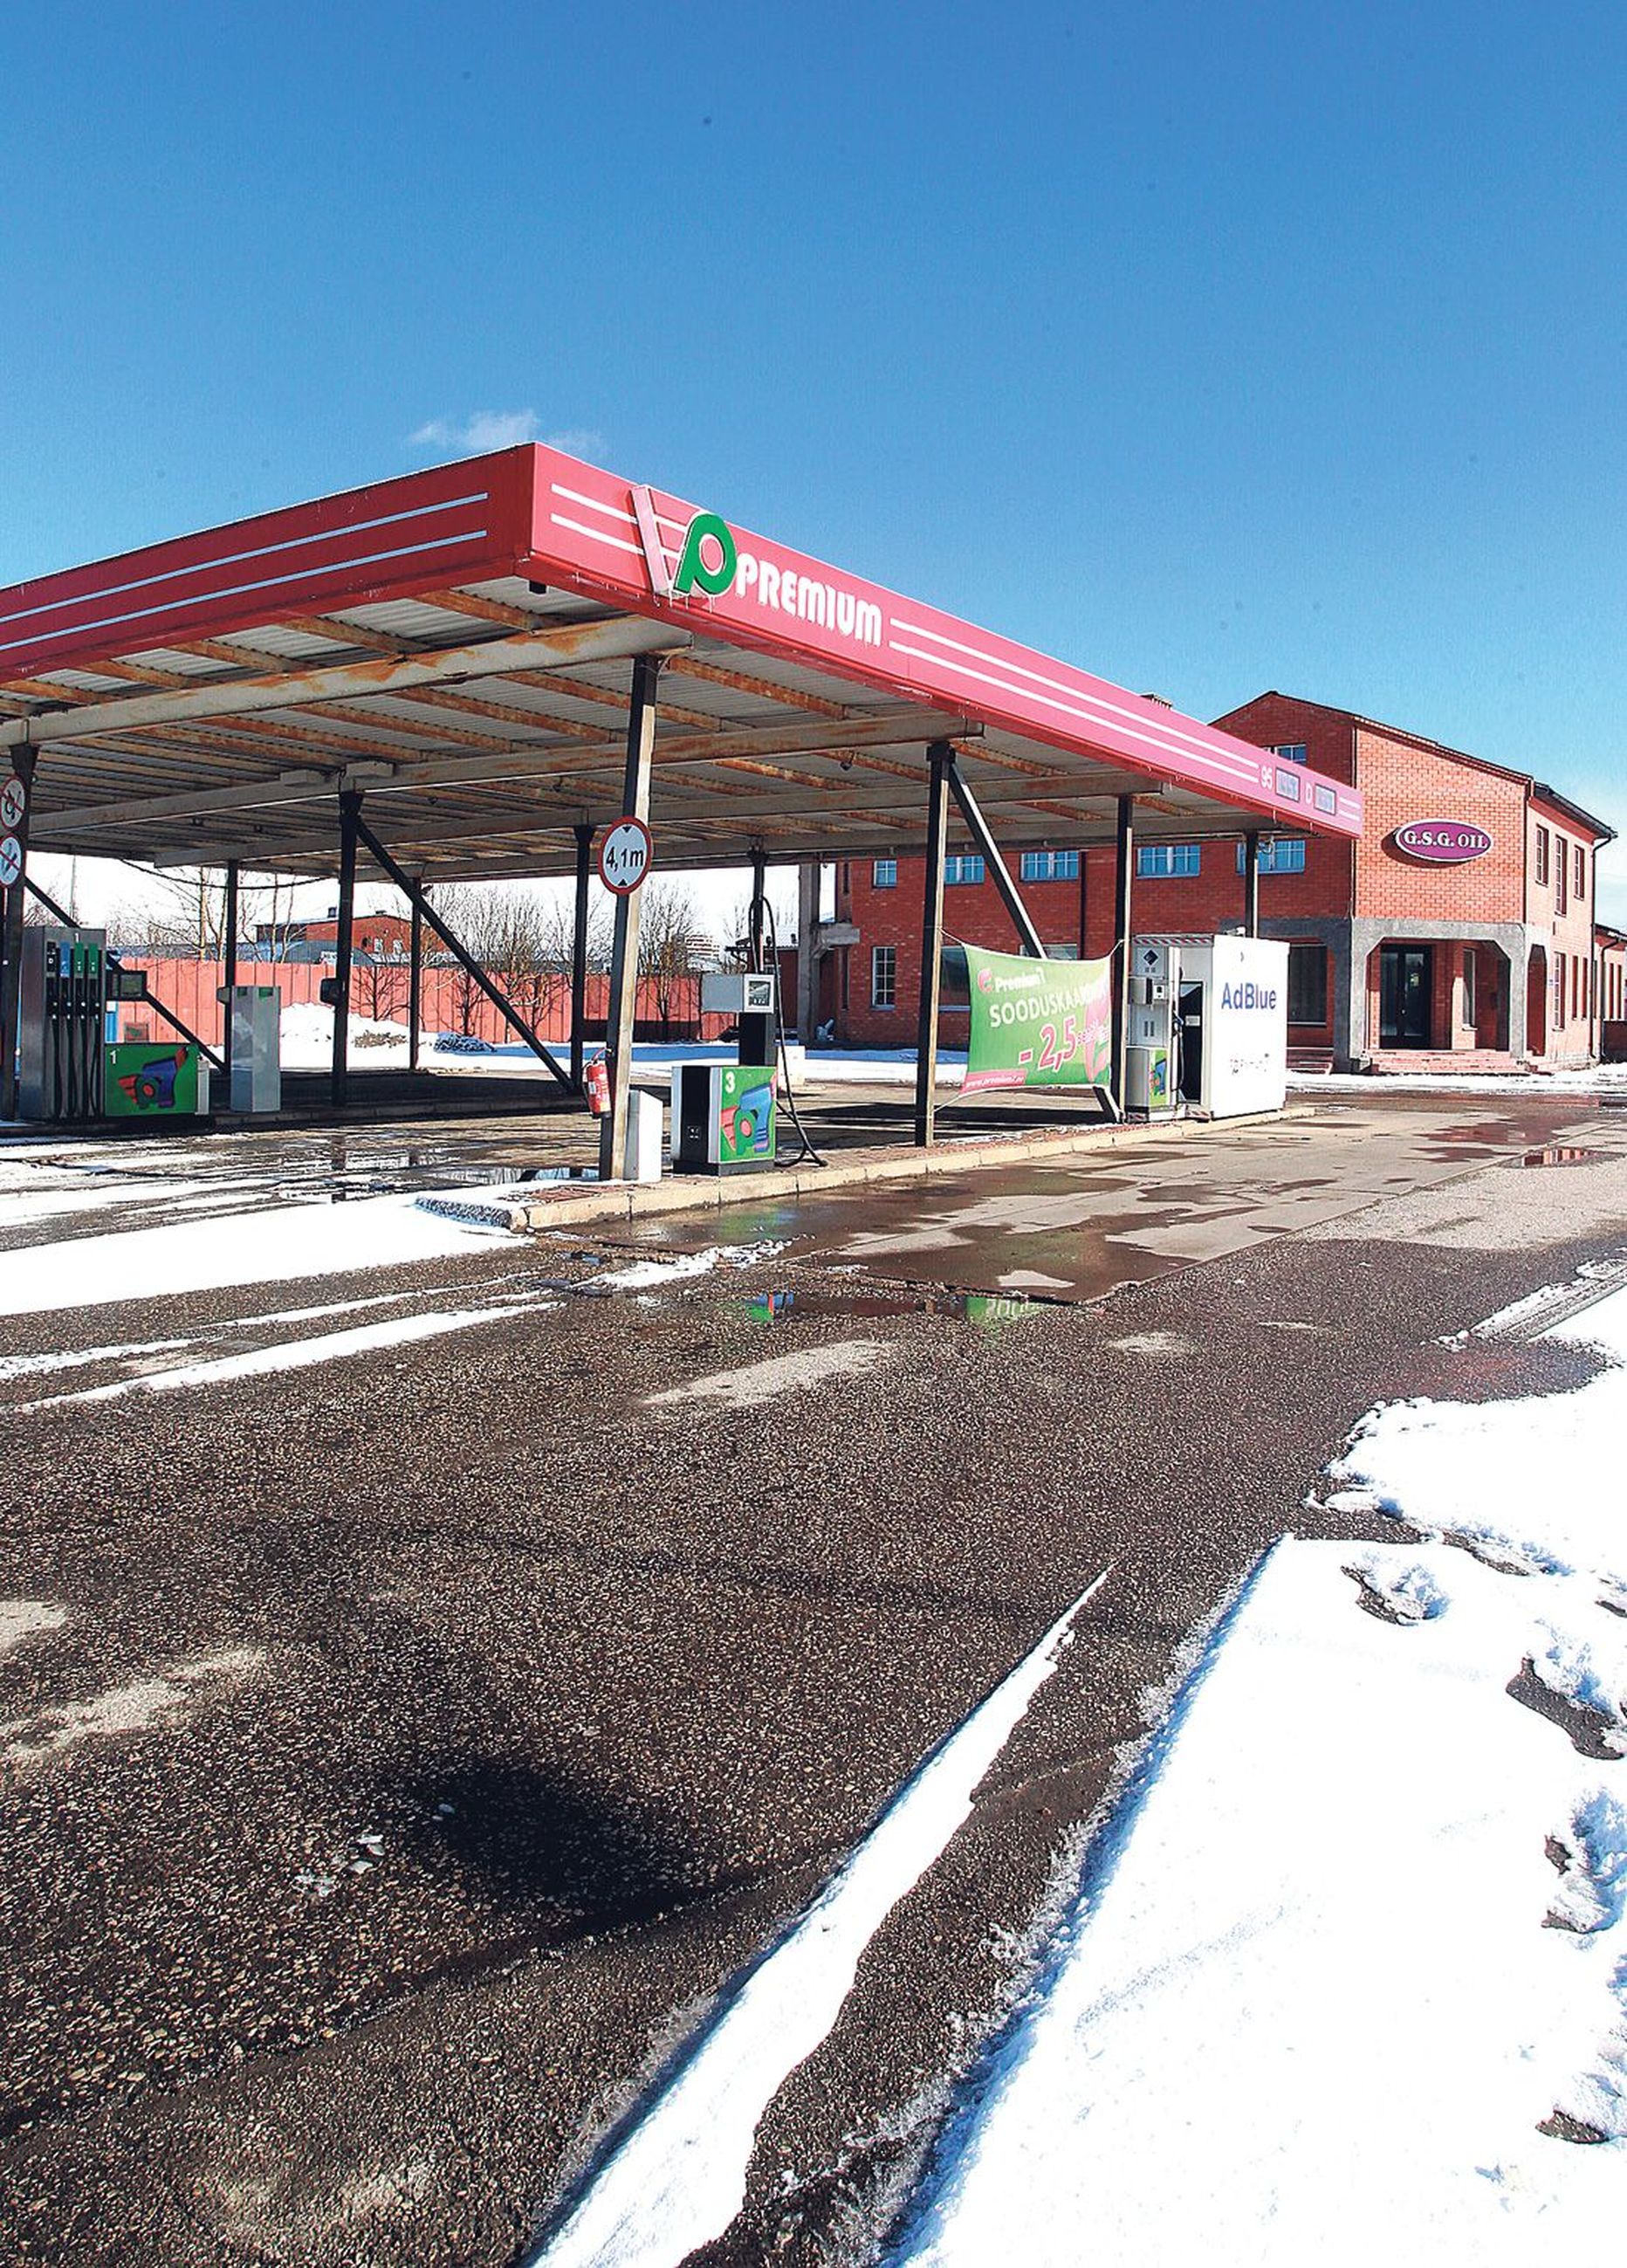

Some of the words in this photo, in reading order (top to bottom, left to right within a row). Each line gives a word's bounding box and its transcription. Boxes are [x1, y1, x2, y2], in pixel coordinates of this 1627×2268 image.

[735, 553, 882, 647] PREMIUM
[1261, 766, 1273, 790] 95
[1404, 831, 1454, 848] G.S.G.
[1458, 834, 1487, 849] OIL
[1221, 982, 1277, 1010] AdBlue
[110, 1050, 117, 1064] 1
[725, 1071, 735, 1093] 3
